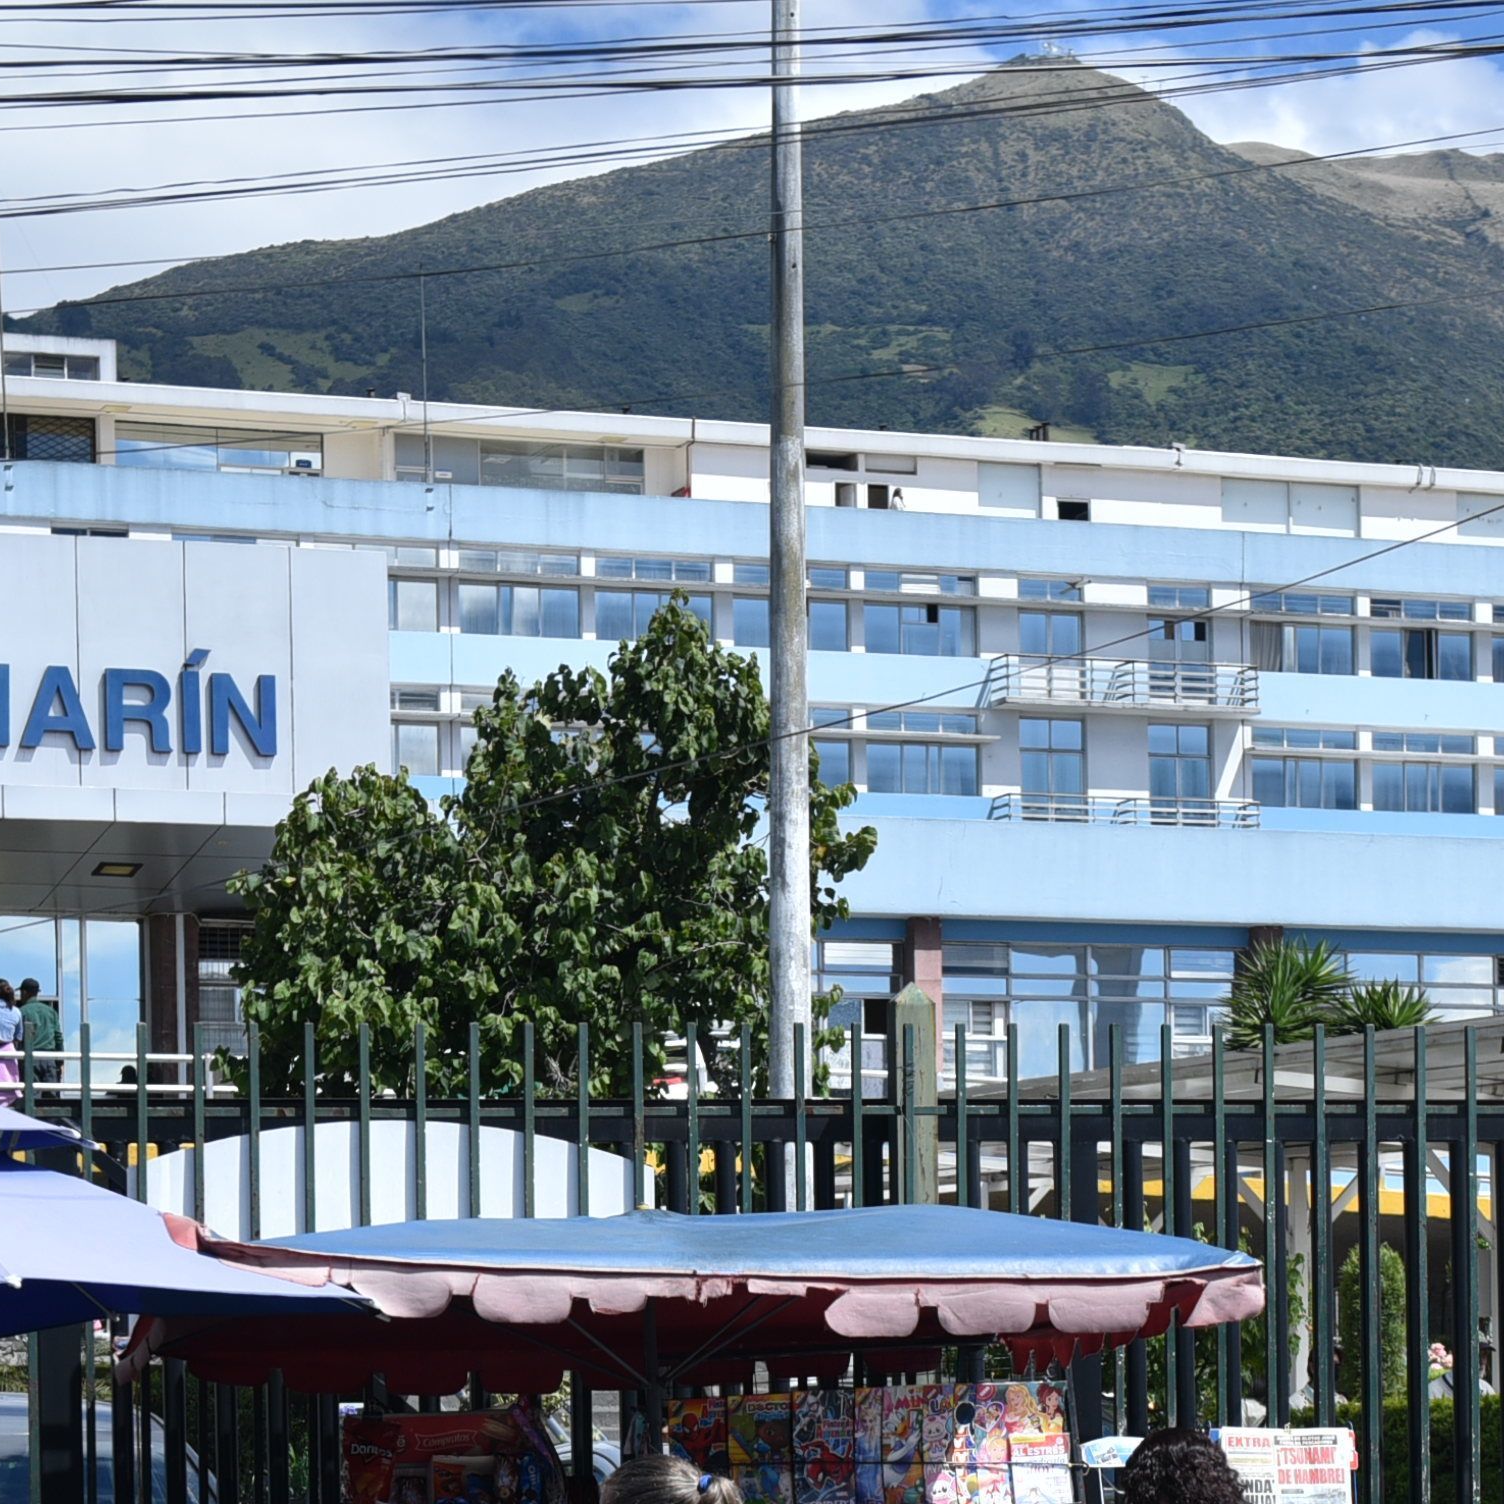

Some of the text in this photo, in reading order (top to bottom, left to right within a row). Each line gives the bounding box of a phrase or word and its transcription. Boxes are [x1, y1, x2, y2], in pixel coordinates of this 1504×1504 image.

[1227, 1436, 1272, 1448] EXTRA
[1278, 1467, 1345, 1485] DE HAMBRE!
